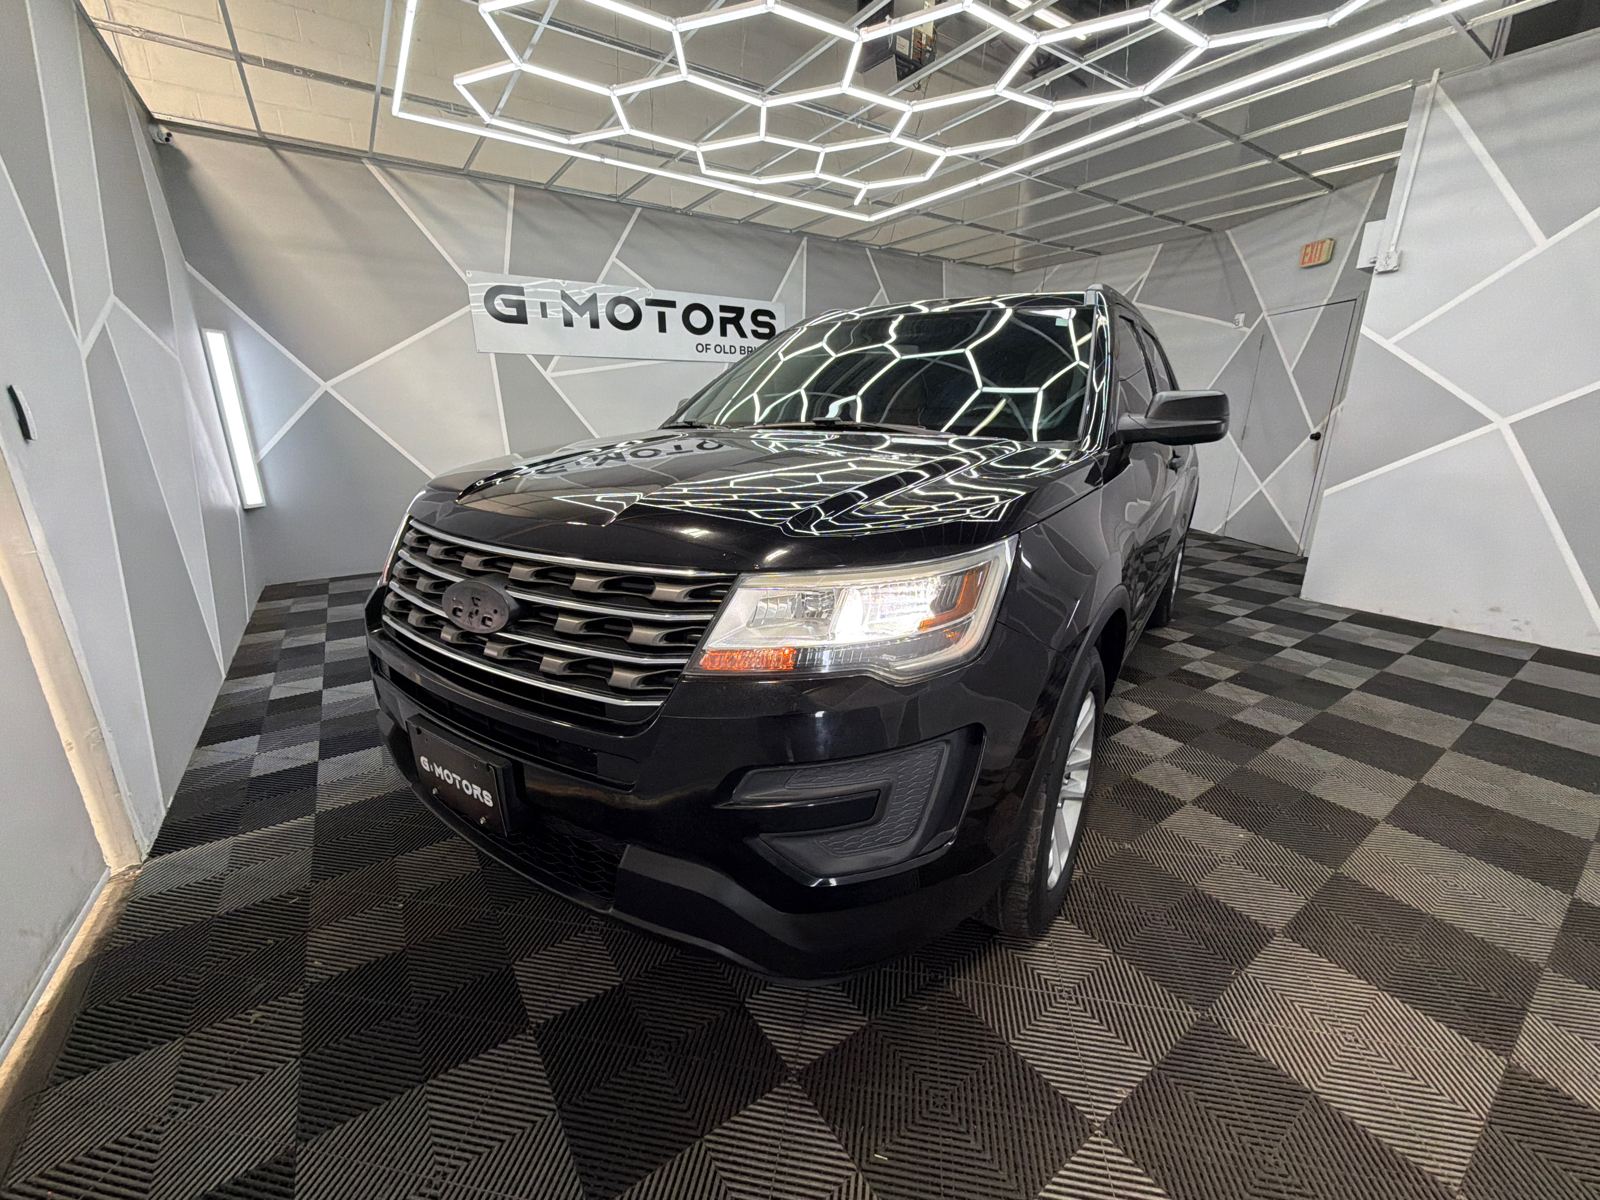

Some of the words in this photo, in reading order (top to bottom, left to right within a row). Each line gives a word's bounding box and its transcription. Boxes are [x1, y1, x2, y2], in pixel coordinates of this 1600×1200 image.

[1301, 240, 1326, 266] EXIT
[695, 342, 712, 354] OF
[713, 343, 737, 355] OLD
